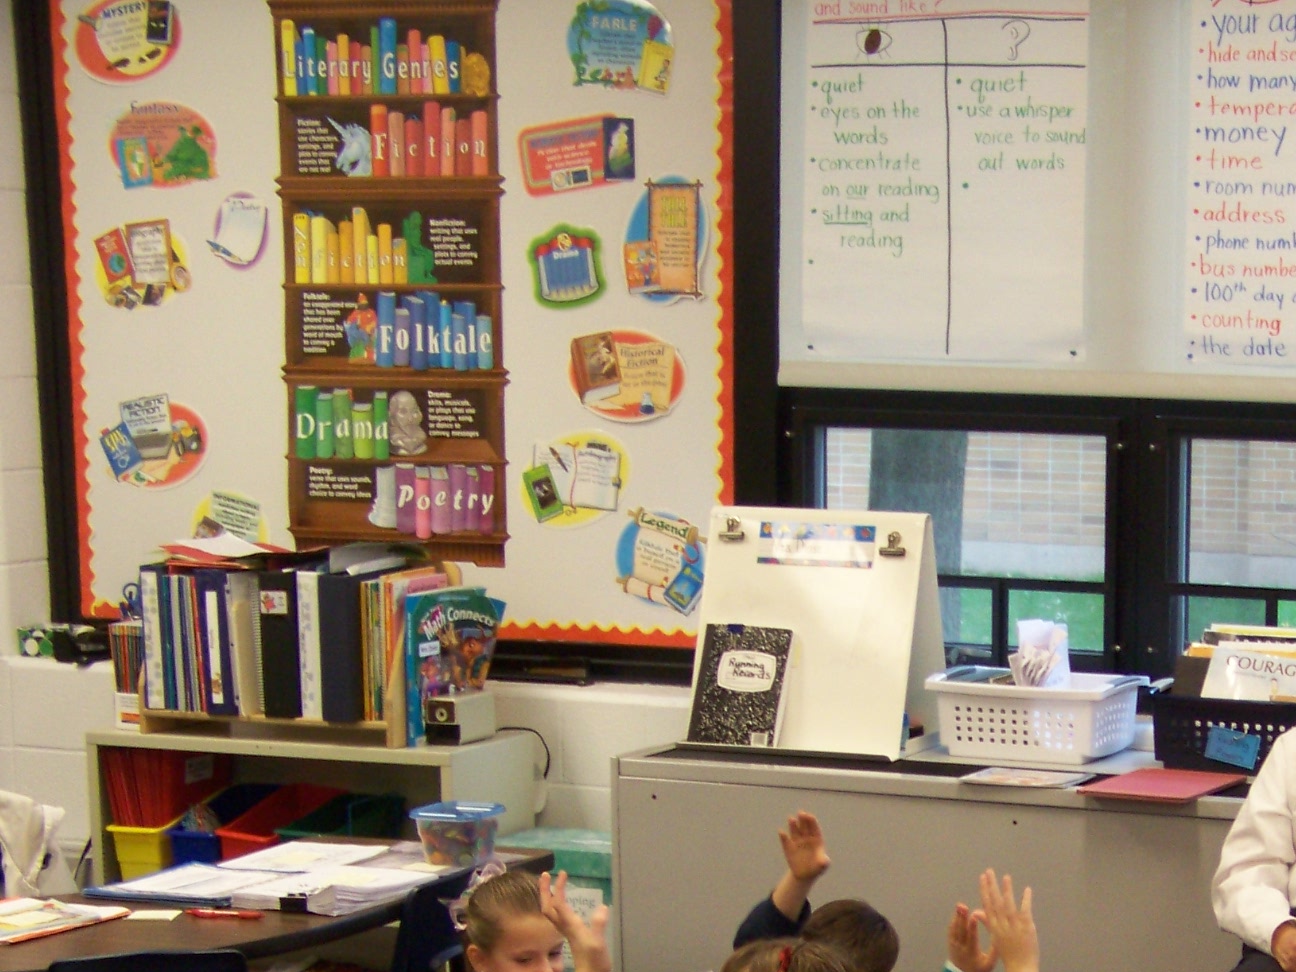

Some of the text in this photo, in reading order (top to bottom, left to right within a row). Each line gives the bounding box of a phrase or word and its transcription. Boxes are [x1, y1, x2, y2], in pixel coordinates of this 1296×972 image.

[1212, 15, 1260, 46] your
[1208, 42, 1240, 62] hide
[283, 51, 459, 84] Literary Genres
[1206, 68, 1240, 88] how
[821, 73, 864, 103] quiet
[970, 71, 1027, 102] quiet
[820, 99, 920, 123] eyes the
[966, 96, 1073, 122] use whisper
[374, 133, 486, 160] Fiction
[834, 124, 888, 145] words
[975, 130, 1014, 144] voice
[1205, 126, 1287, 156] money
[818, 153, 920, 171] concentrate
[1016, 152, 1065, 170] words
[1209, 154, 1263, 170] time
[878, 177, 940, 204] reading
[1205, 182, 1253, 195] room
[880, 204, 910, 223] and
[1203, 202, 1285, 223] address
[840, 228, 903, 258] reading
[1206, 230, 1249, 254] phone
[1200, 254, 1235, 276] bus
[1253, 286, 1284, 309] day
[1202, 310, 1281, 336] counting
[380, 324, 491, 354] Folktale
[1201, 337, 1287, 357] the date
[296, 414, 388, 440] Drama
[398, 485, 494, 515] Poetry
[641, 512, 689, 538] Legend
[424, 607, 495, 640] Math Connects
[729, 657, 765, 675] Running
